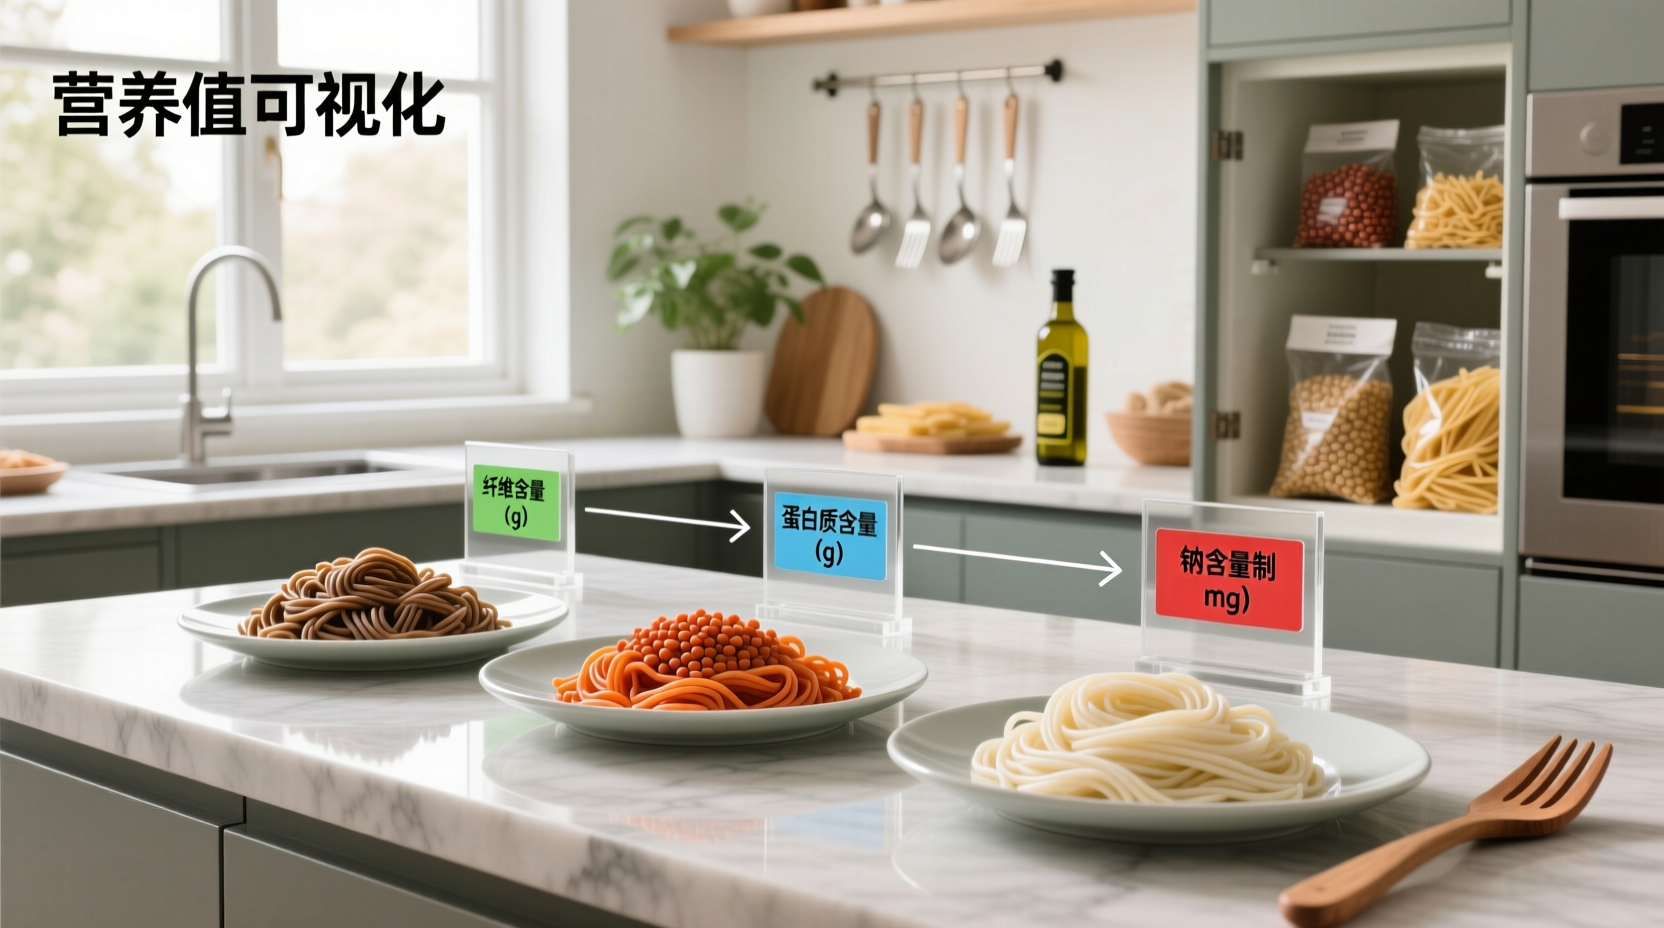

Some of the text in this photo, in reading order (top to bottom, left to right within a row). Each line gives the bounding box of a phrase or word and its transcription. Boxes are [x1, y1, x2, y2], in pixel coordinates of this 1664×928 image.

[482, 474, 546, 502] 纤维含量
[504, 505, 528, 531] (g)
[781, 504, 877, 538] 蛋白质含量
[815, 538, 844, 569] (g)
[1180, 545, 1276, 582] 钠含量制
[1204, 585, 1250, 616] mg)
